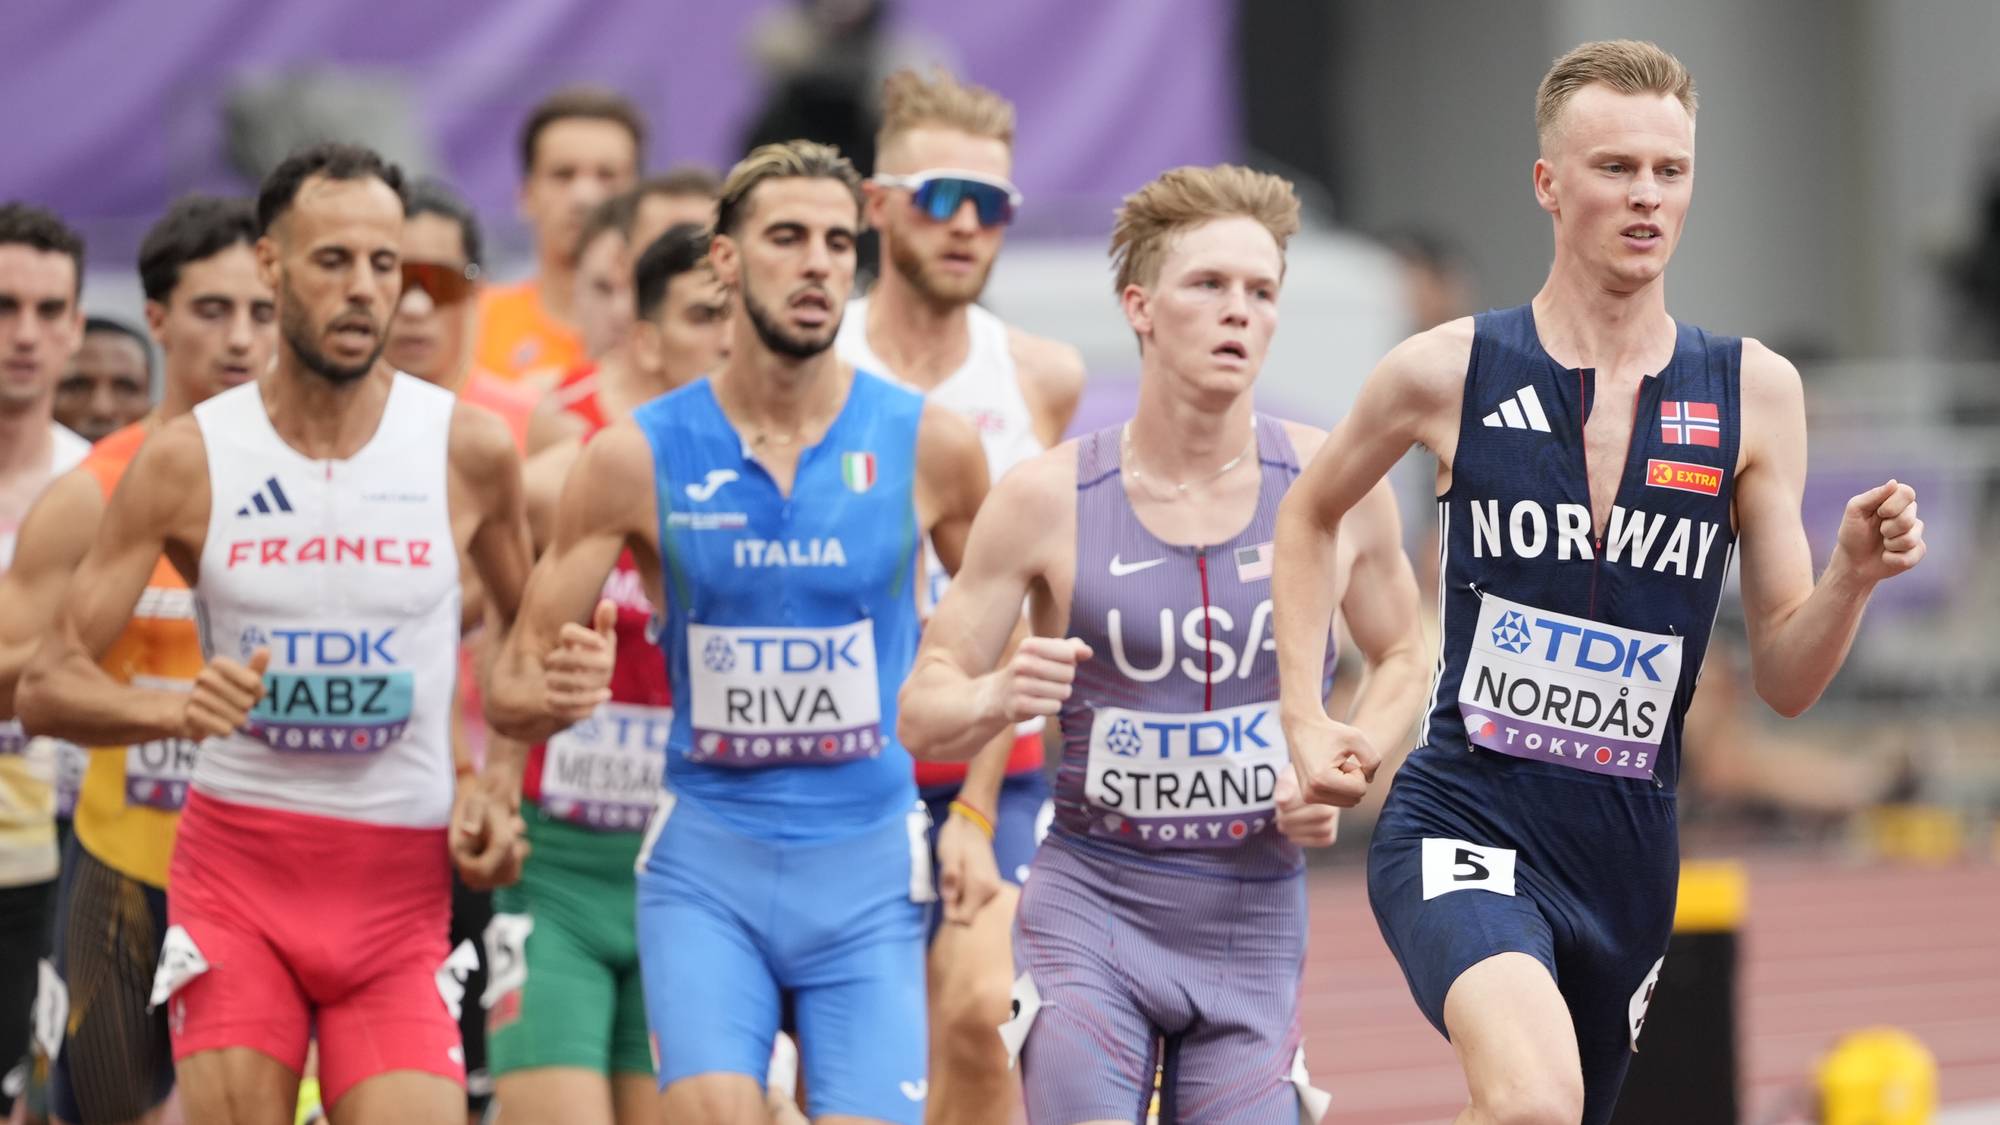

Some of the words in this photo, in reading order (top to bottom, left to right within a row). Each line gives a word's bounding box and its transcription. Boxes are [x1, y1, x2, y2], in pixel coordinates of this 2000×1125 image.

[1676, 470, 1718, 488] EXTRA
[228, 535, 431, 569] FRANCE
[733, 538, 847, 568] ITALIA
[1470, 499, 1719, 580] NORWAY
[272, 627, 398, 666] TDK
[737, 633, 861, 673] TDK
[1535, 617, 1668, 682] TDK
[726, 687, 841, 724] RIVA
[1473, 665, 1657, 738] NORDÅS
[1143, 710, 1271, 758] TDK
[557, 752, 661, 794] MESSA
[1099, 763, 1278, 810] STRAND
[1453, 848, 1490, 881] 5
